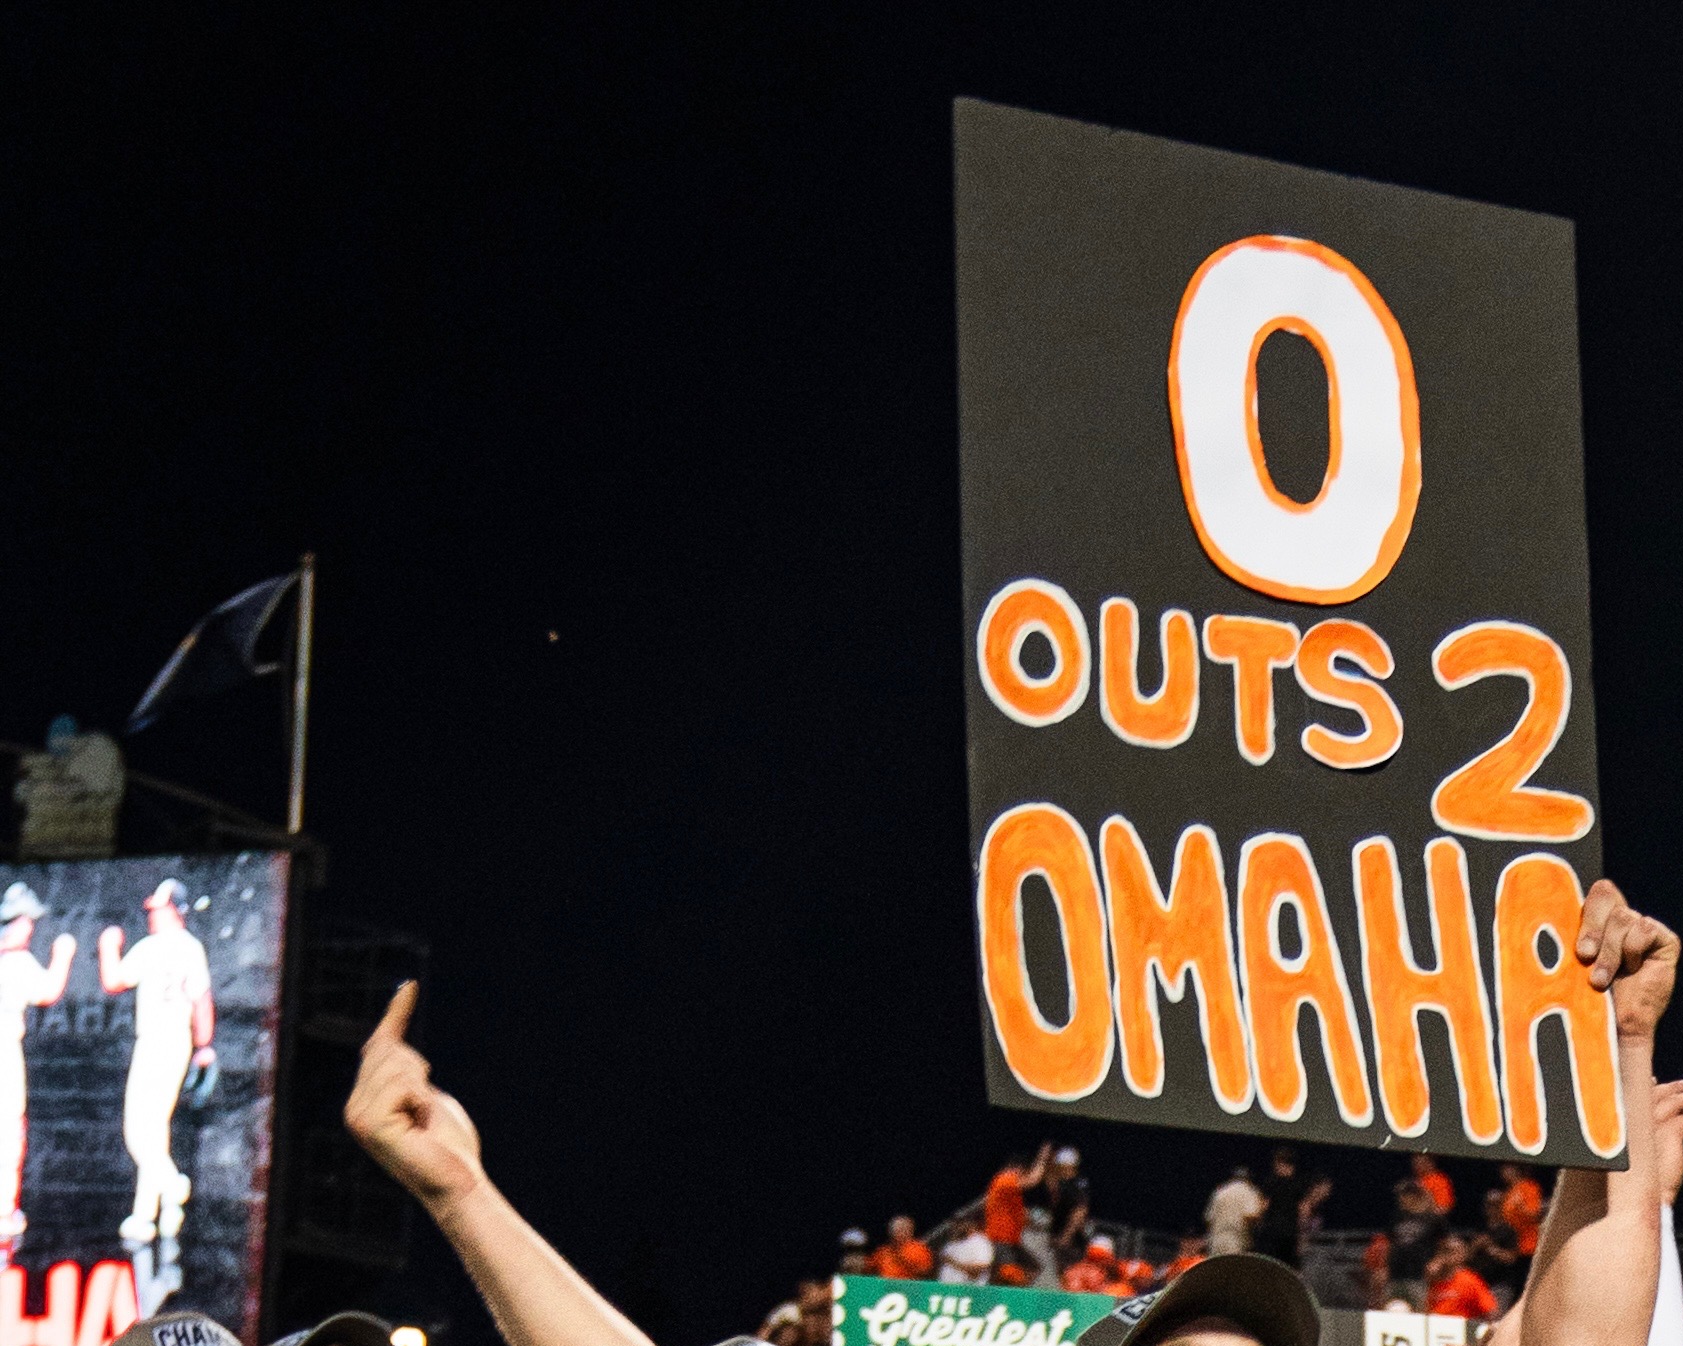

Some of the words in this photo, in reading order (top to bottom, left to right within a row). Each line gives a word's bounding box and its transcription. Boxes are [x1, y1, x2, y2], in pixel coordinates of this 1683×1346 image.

[977, 577, 1402, 770] OUTS
[1431, 620, 1595, 841] 2
[978, 802, 1626, 1158] OMAHA
[929, 1294, 972, 1316] THE
